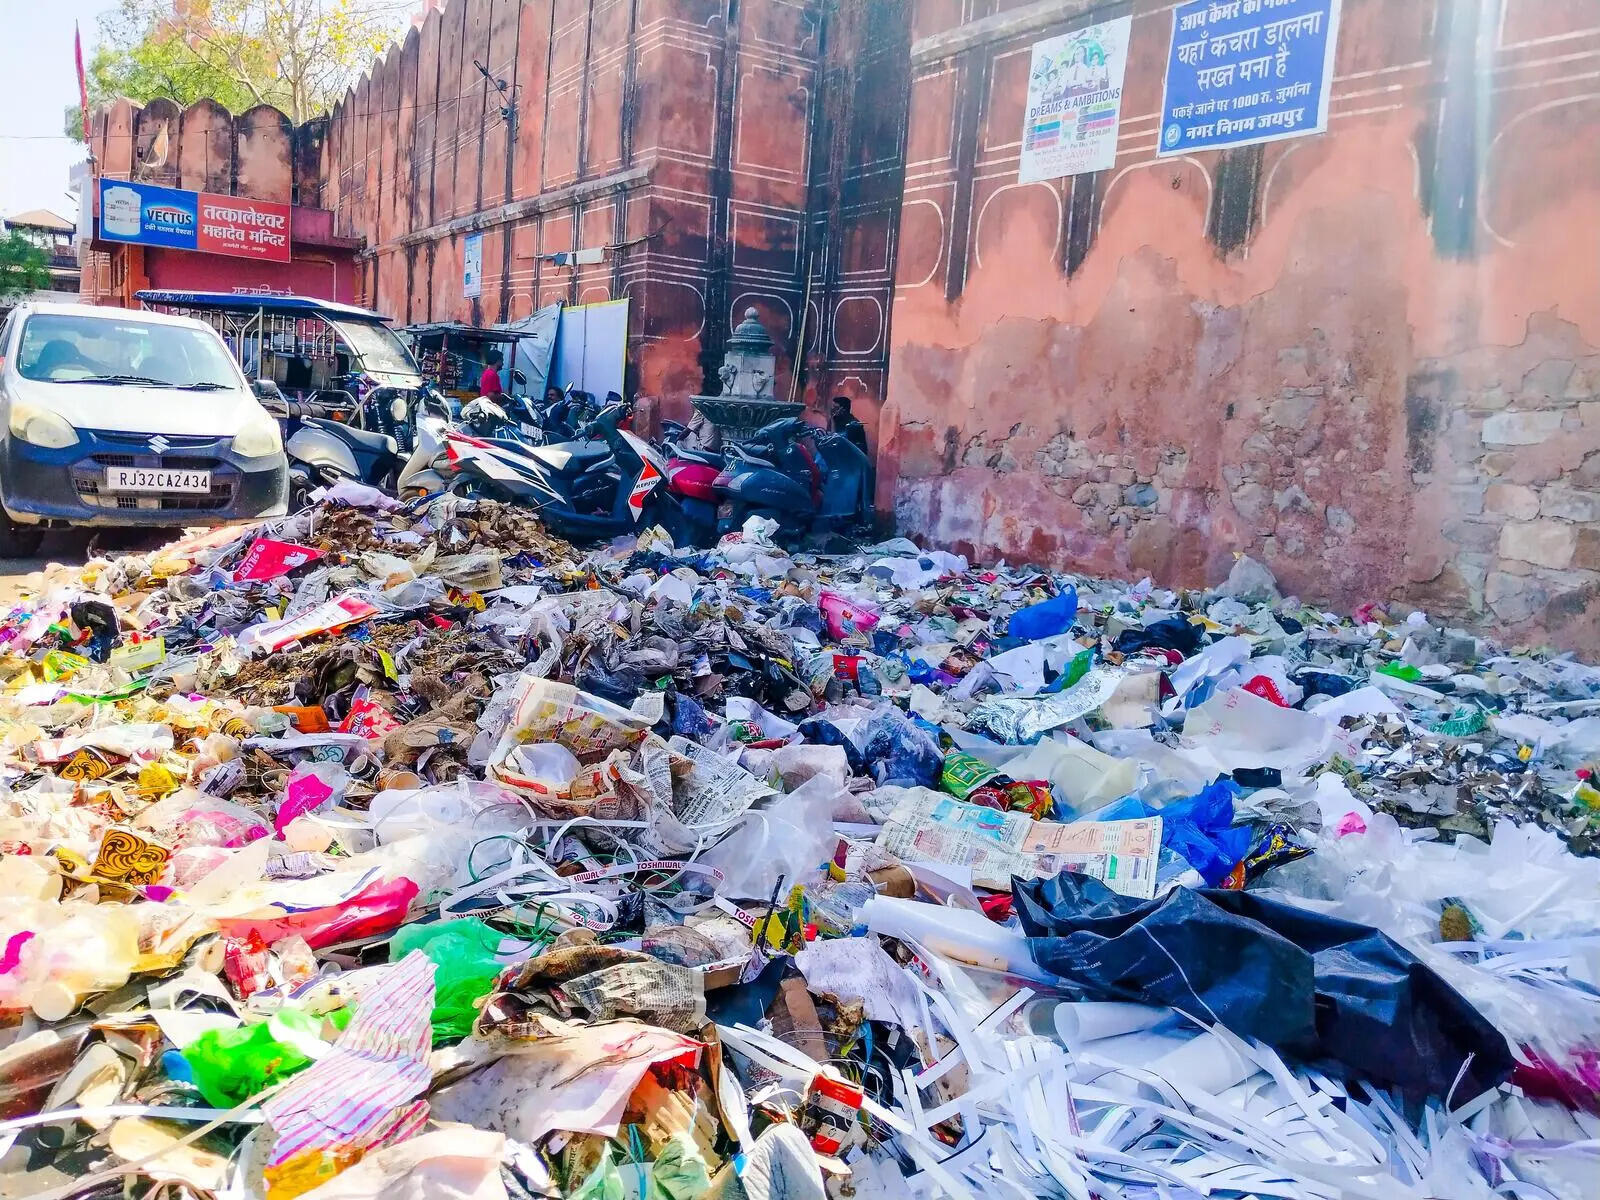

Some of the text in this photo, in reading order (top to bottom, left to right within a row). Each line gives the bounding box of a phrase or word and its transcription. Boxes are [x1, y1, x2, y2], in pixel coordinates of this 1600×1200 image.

[1180, 10, 1208, 31] आप
[1177, 11, 1324, 66] यहाँ कचरा डालना
[1239, 56, 1273, 82] मना
[1275, 43, 1291, 78] है
[1030, 87, 1120, 118] DREAMS & AMBITIONS
[1194, 99, 1215, 116] जाने
[1216, 99, 1229, 112] पर
[1232, 93, 1259, 110] 1000
[1186, 107, 1305, 140] नगर निगम जयपुर
[146, 208, 192, 225] VECTUS
[203, 204, 285, 230] तत्कालेश्वर
[203, 224, 286, 247] महादेव मन्दिर
[120, 472, 208, 489] RJ32CA2434
[636, 478, 659, 489] REPSOL
[637, 861, 682, 870] TOSHNIWAL
